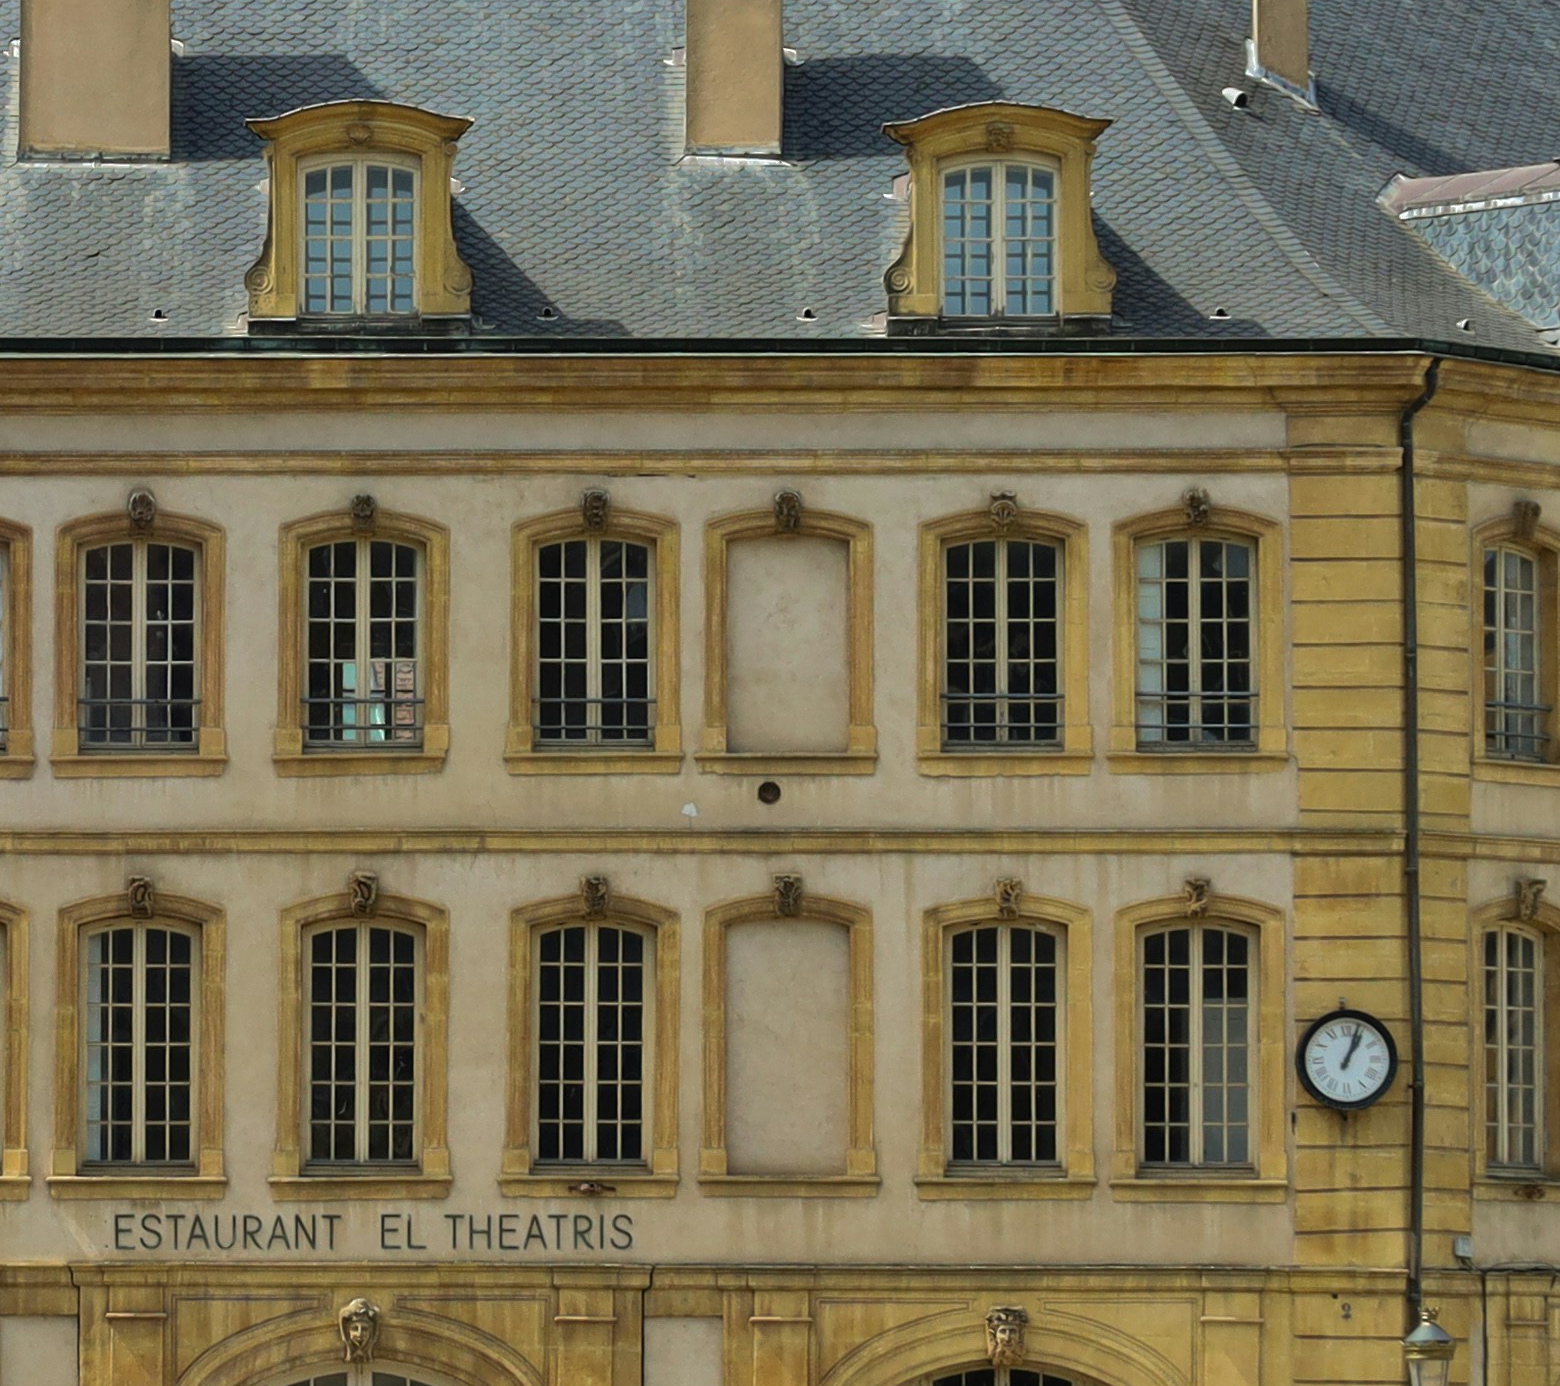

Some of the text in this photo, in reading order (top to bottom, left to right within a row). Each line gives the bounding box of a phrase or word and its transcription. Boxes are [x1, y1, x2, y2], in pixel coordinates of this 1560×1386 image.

[114, 1213, 634, 1251] ESTAURANT EL THEATRIS
